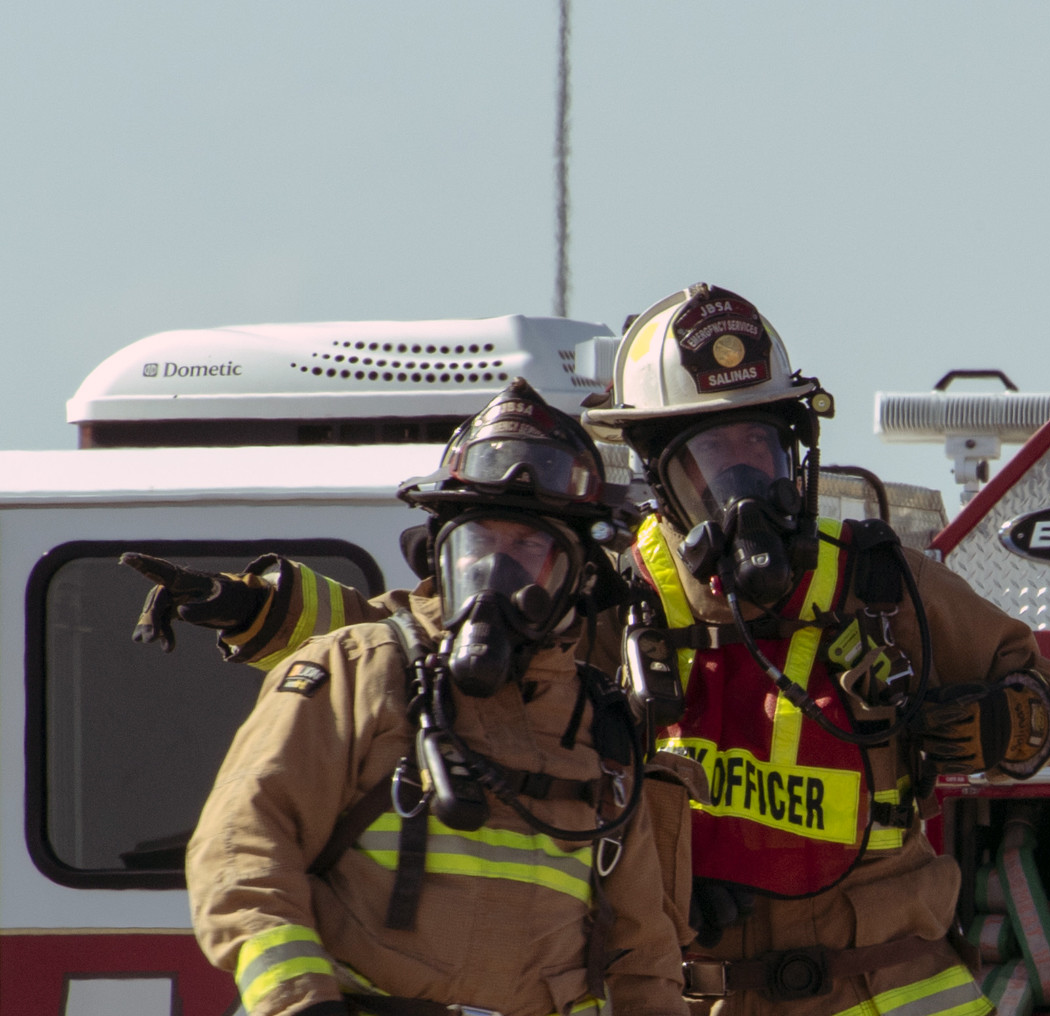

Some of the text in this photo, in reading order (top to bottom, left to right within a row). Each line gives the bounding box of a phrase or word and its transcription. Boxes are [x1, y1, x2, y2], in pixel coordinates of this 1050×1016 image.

[700, 301, 733, 317] JBSA
[686, 319, 758, 347] EMERGENCY SERVICES
[163, 361, 242, 377] Dometic
[708, 367, 757, 386] SALINAS
[710, 757, 825, 830] OFFICER
